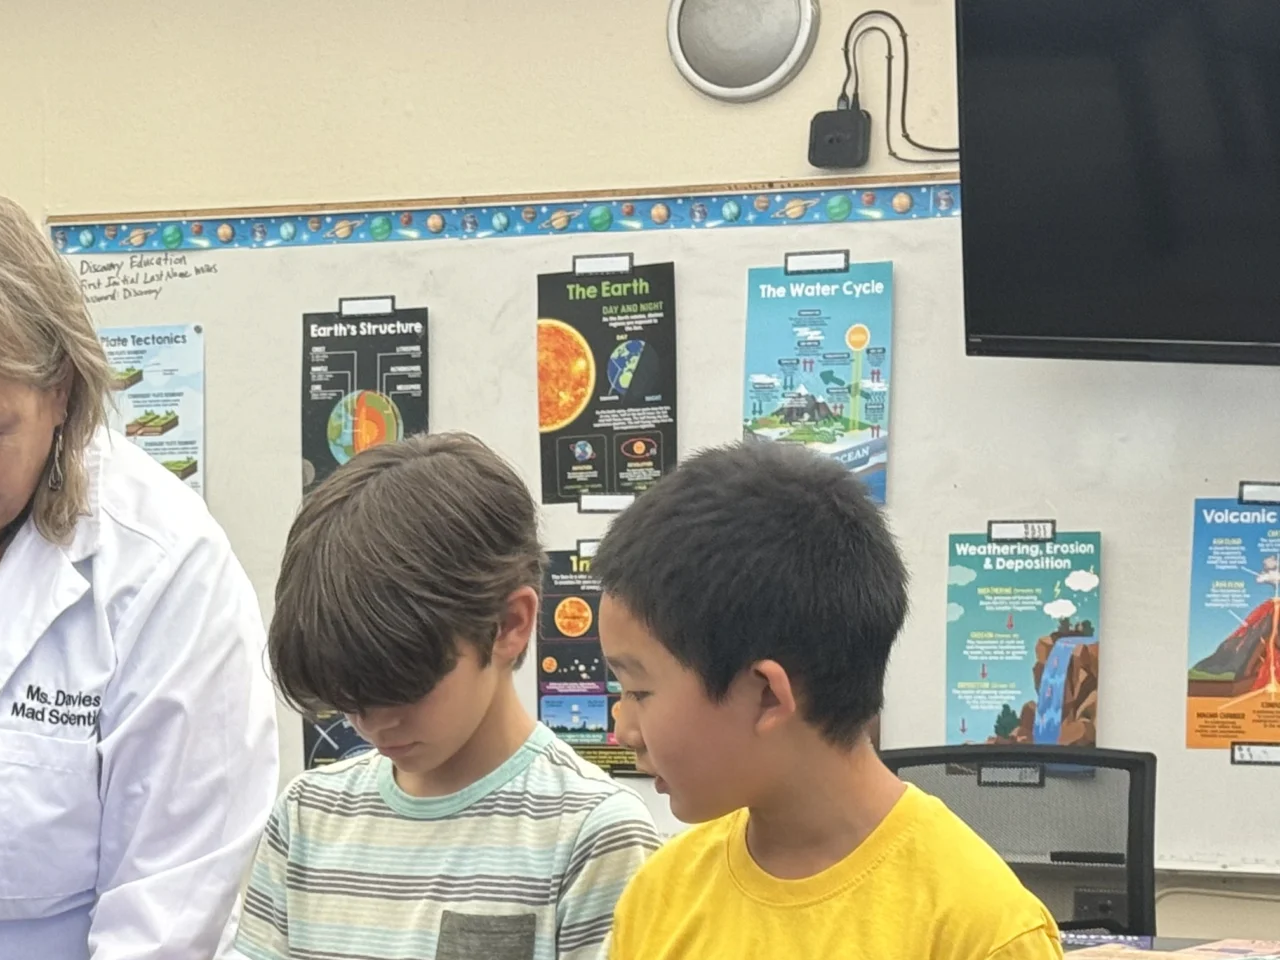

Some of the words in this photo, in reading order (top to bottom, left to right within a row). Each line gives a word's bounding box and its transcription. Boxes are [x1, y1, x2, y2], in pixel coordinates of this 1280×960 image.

[130, 252, 187, 269] Education
[566, 283, 598, 300] The
[601, 278, 650, 297] Earth
[759, 284, 786, 298] The
[790, 283, 839, 297] Water
[842, 280, 884, 298] Cycle
[602, 305, 619, 315] DAY
[620, 303, 638, 313] AND
[640, 301, 664, 312] NIGHT
[310, 322, 357, 337] Earth's
[359, 320, 423, 336] Structure
[130, 333, 187, 346] Tectonics
[1202, 508, 1278, 524] Volcanic
[955, 541, 1043, 557] Weathering,
[1046, 541, 1095, 554] Erosion
[983, 557, 993, 570] &
[996, 557, 1071, 572] Deposition
[26, 684, 52, 705] Ms.
[55, 689, 101, 707] Davies
[11, 702, 45, 722] Mad
